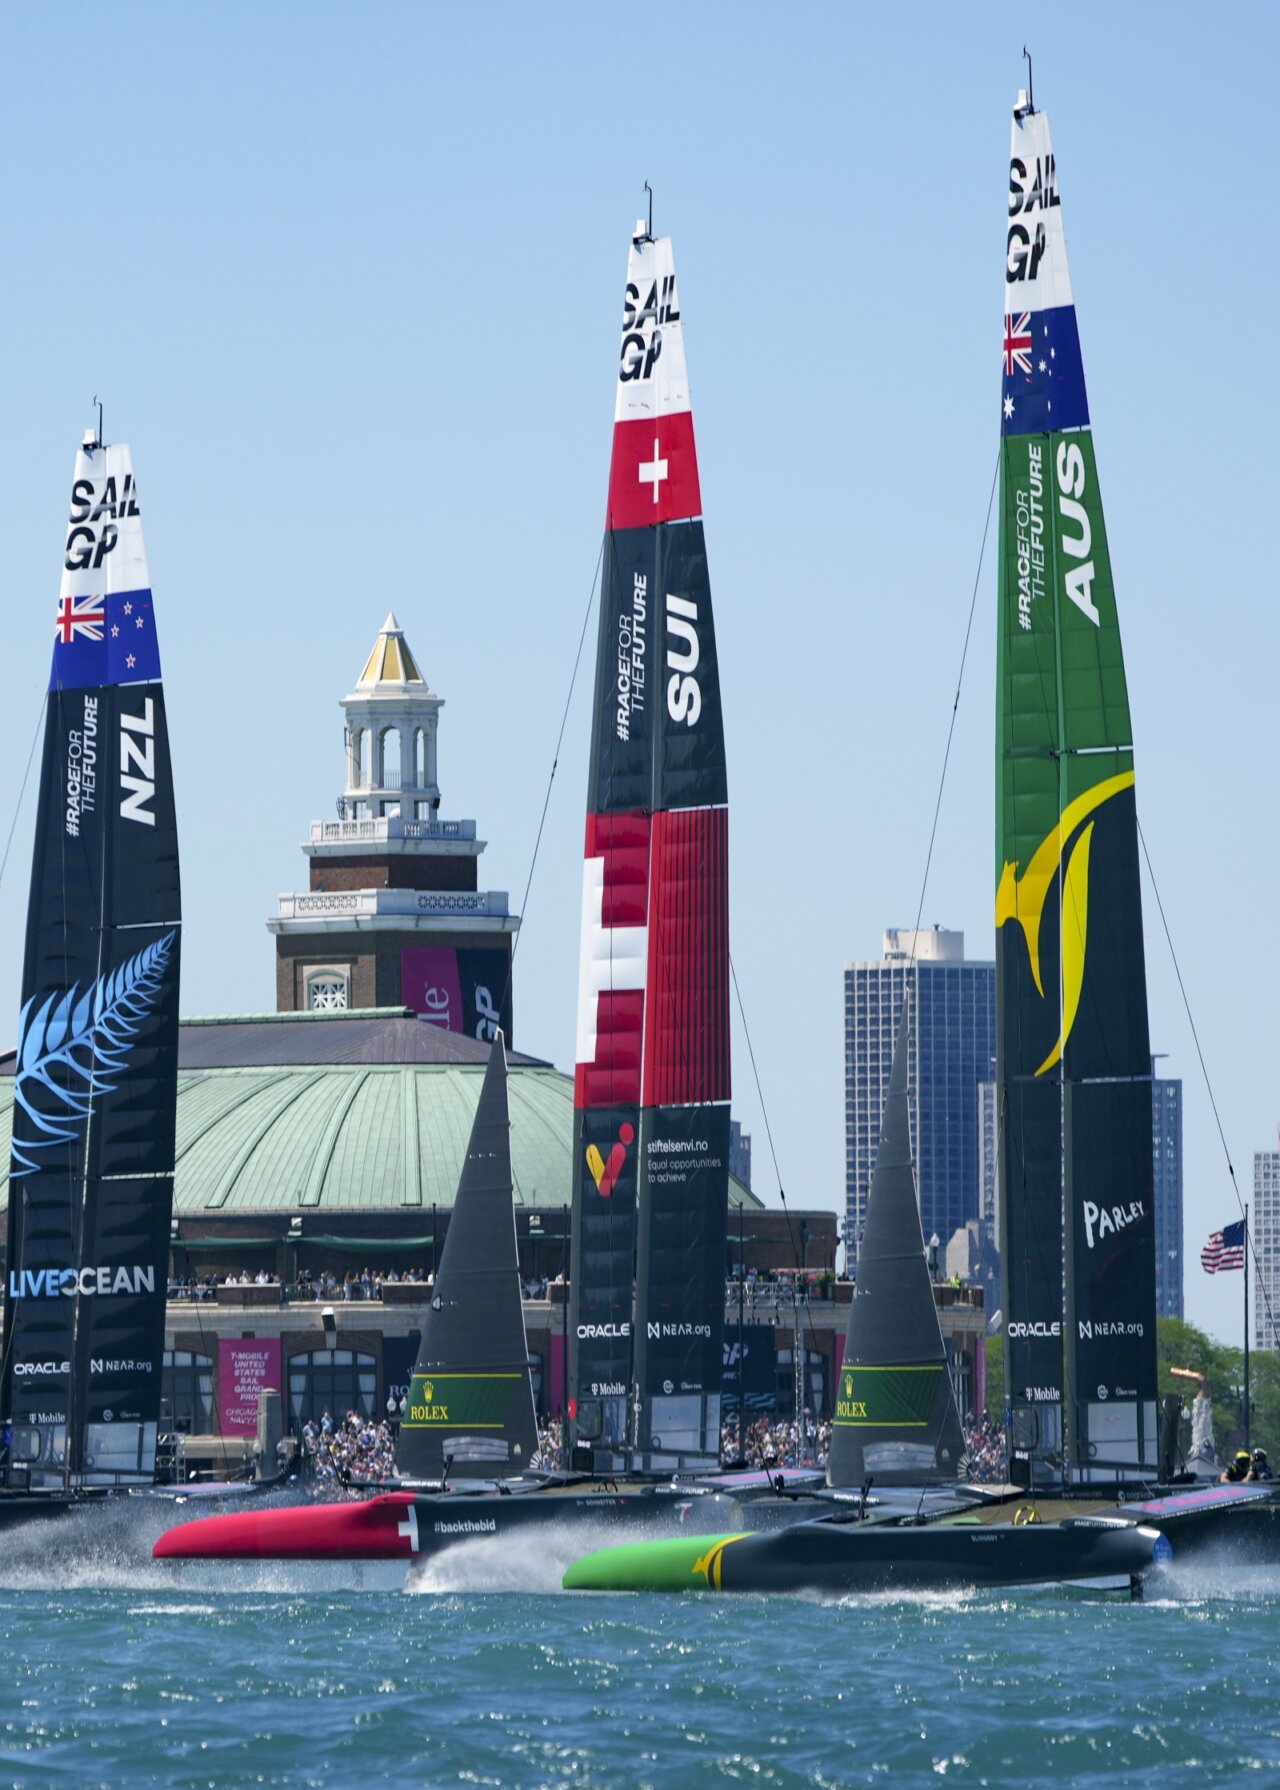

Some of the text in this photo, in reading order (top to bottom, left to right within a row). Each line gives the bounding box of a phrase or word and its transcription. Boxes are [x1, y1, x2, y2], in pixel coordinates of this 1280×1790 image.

[1008, 153, 1061, 217] SAIL
[1006, 222, 1046, 284] GP
[622, 274, 681, 332] SAIL
[619, 330, 662, 382] GP
[69, 474, 140, 524] SAIL
[65, 524, 118, 571] GP
[1056, 439, 1101, 629] AUS
[666, 592, 702, 728] SUI
[120, 697, 156, 827] NZL
[648, 1159, 668, 1172] Equal
[1083, 1200, 1143, 1249] PARLEY
[577, 1323, 631, 1340] ORACLE
[1008, 1322, 1061, 1338] ORACLE
[13, 1361, 71, 1375] ORACLE
[230, 1352, 270, 1361] T-MOBILE
[234, 1361, 266, 1369] UNITED
[234, 1369, 266, 1377] STATES
[411, 1405, 448, 1420] ROLEX
[837, 1401, 867, 1418] ROLEX
[434, 1519, 496, 1533] #backthebid
